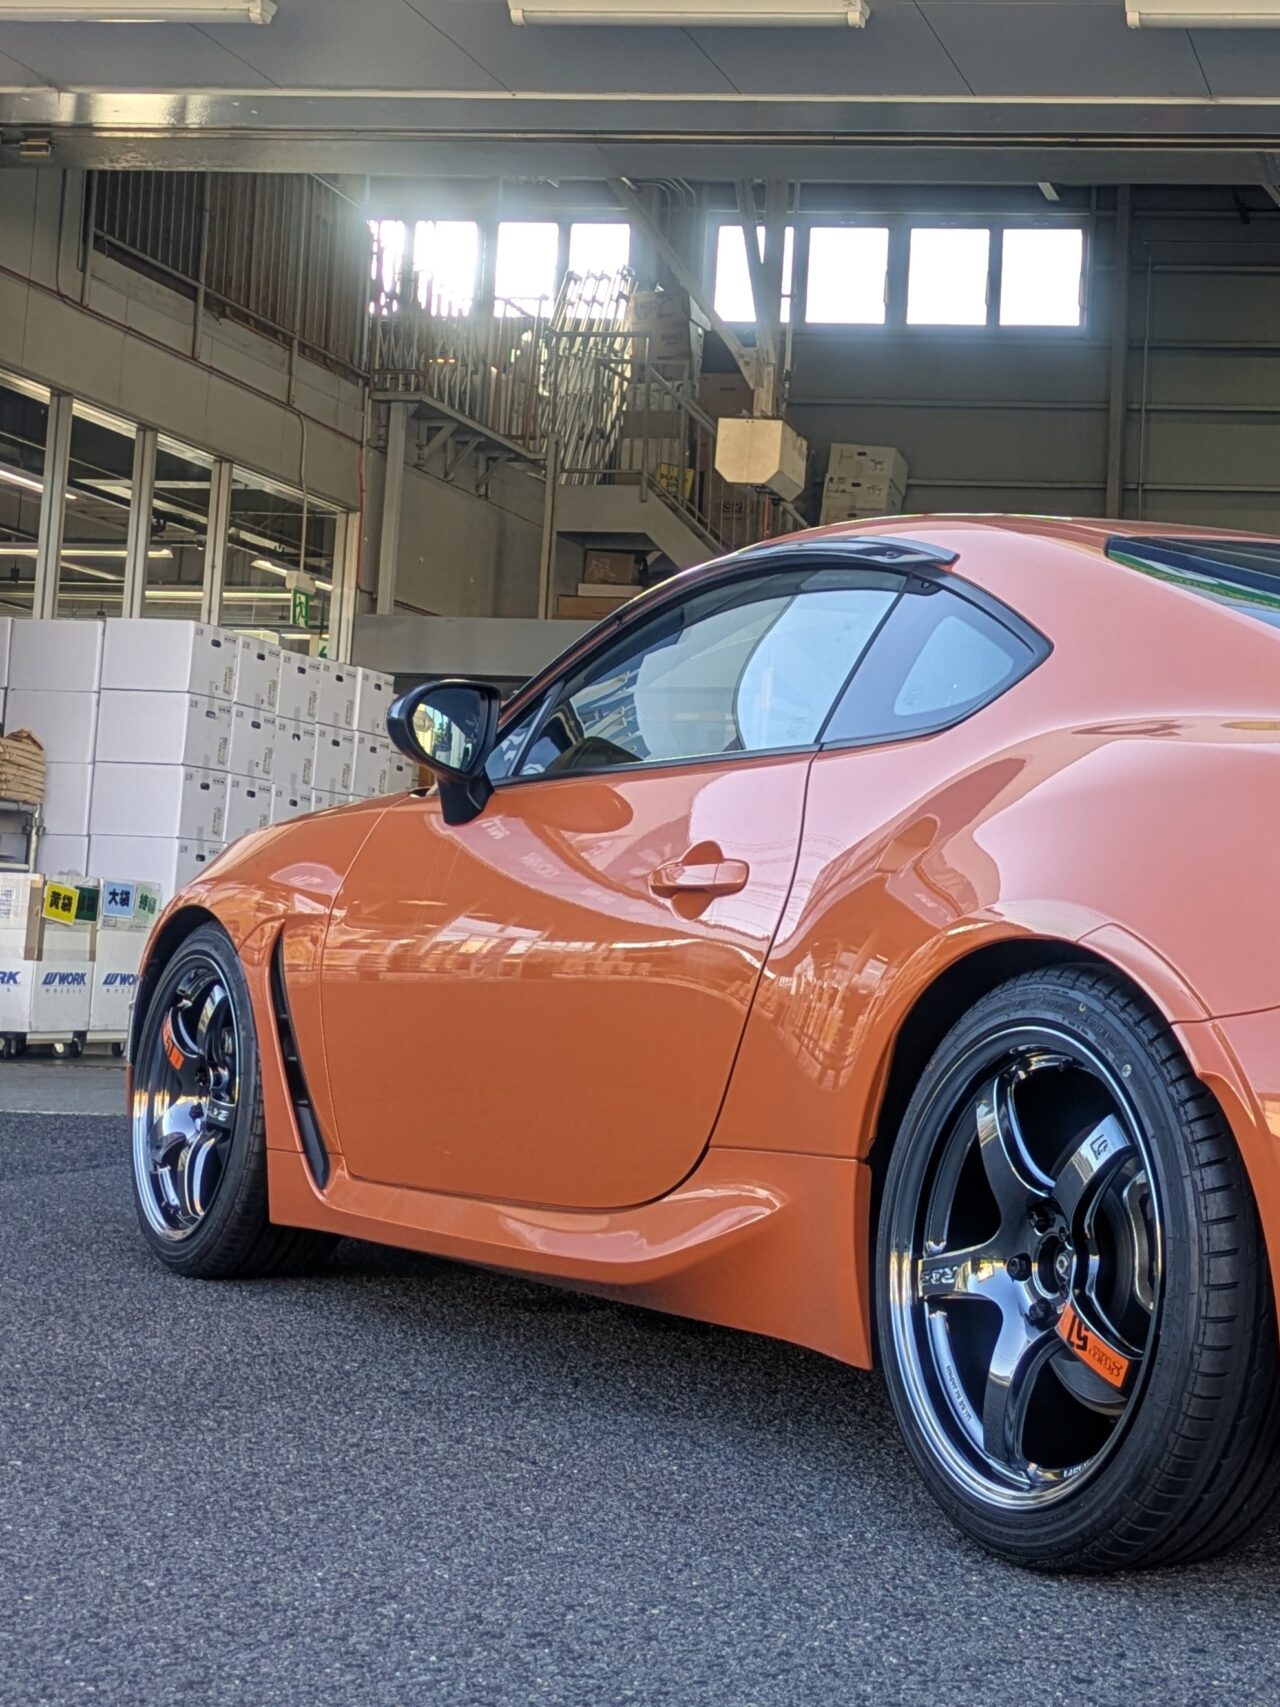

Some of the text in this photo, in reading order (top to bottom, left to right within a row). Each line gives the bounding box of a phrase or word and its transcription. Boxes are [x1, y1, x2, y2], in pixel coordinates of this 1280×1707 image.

[49, 890, 73, 913] 黄袋
[108, 888, 131, 908] 大袋
[58, 972, 87, 985] WORK
